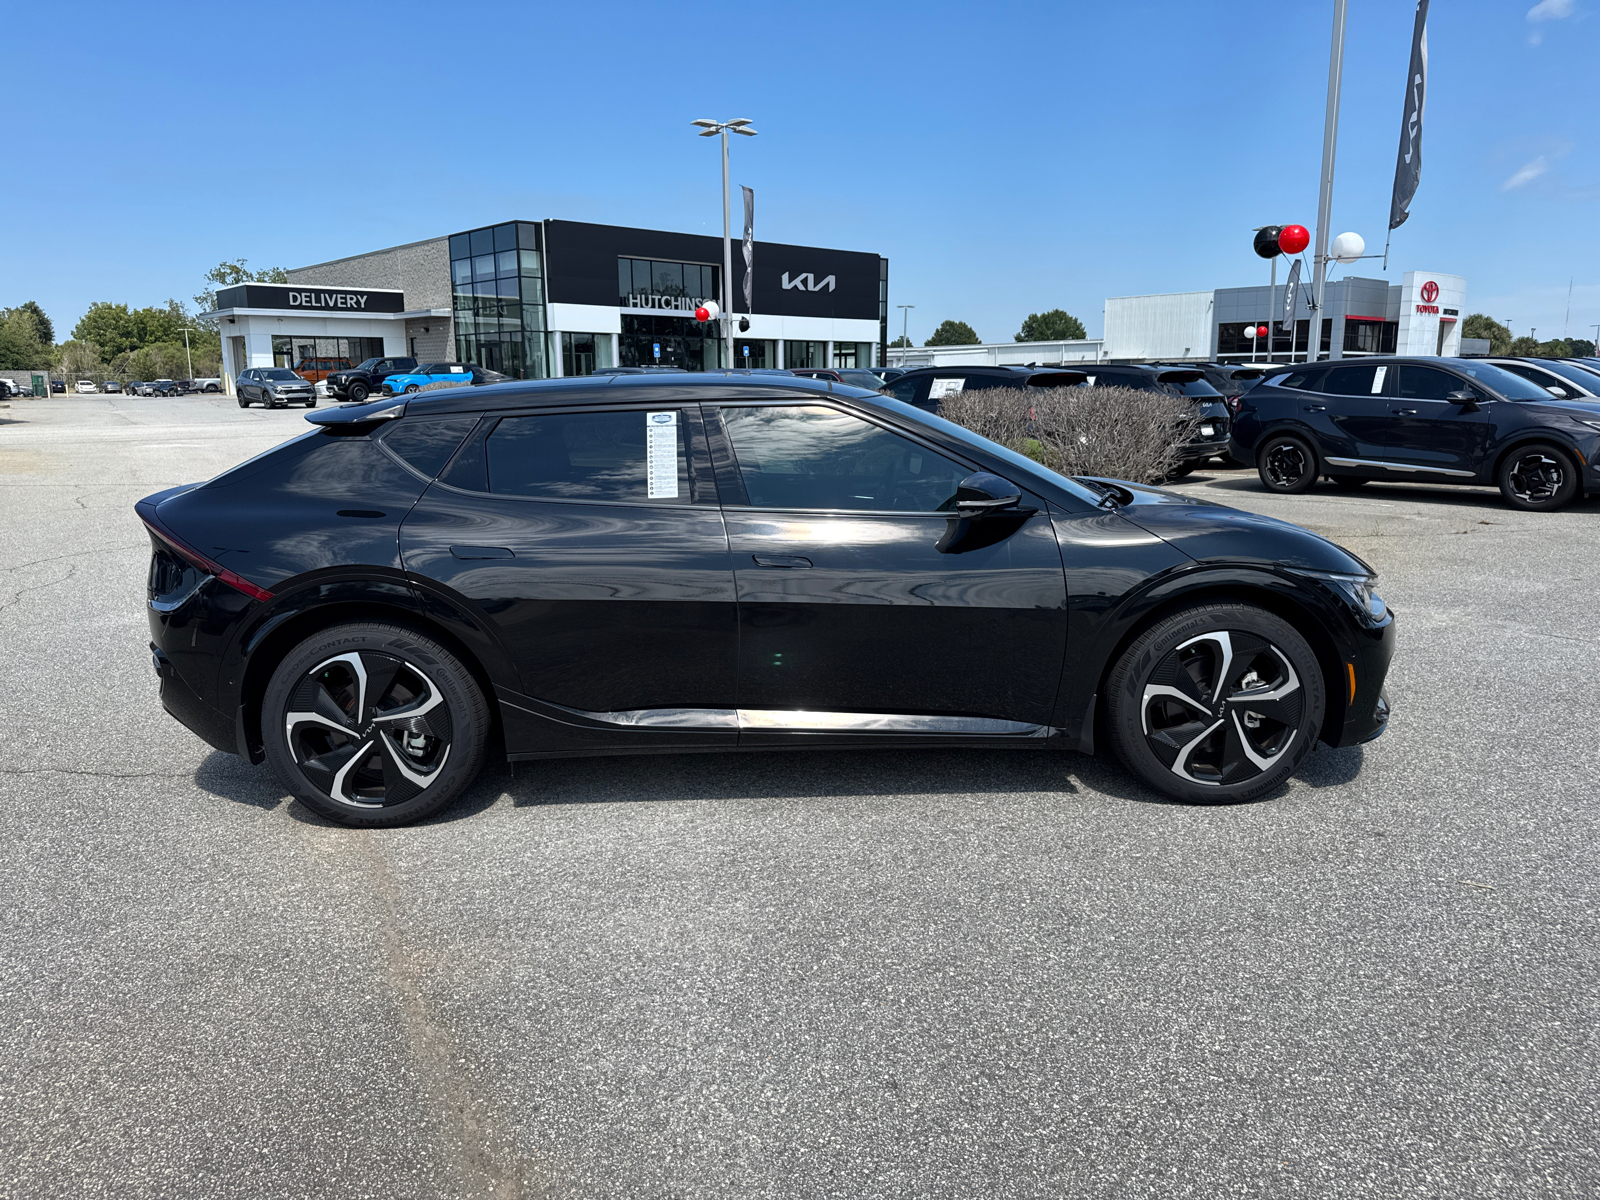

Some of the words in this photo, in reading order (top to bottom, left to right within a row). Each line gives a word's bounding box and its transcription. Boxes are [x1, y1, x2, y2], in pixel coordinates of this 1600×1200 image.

[781, 270, 836, 293] KIA
[288, 291, 368, 309] DELIVERY
[629, 293, 721, 312] HUTCHINS
[1416, 304, 1439, 314] TOYOTA
